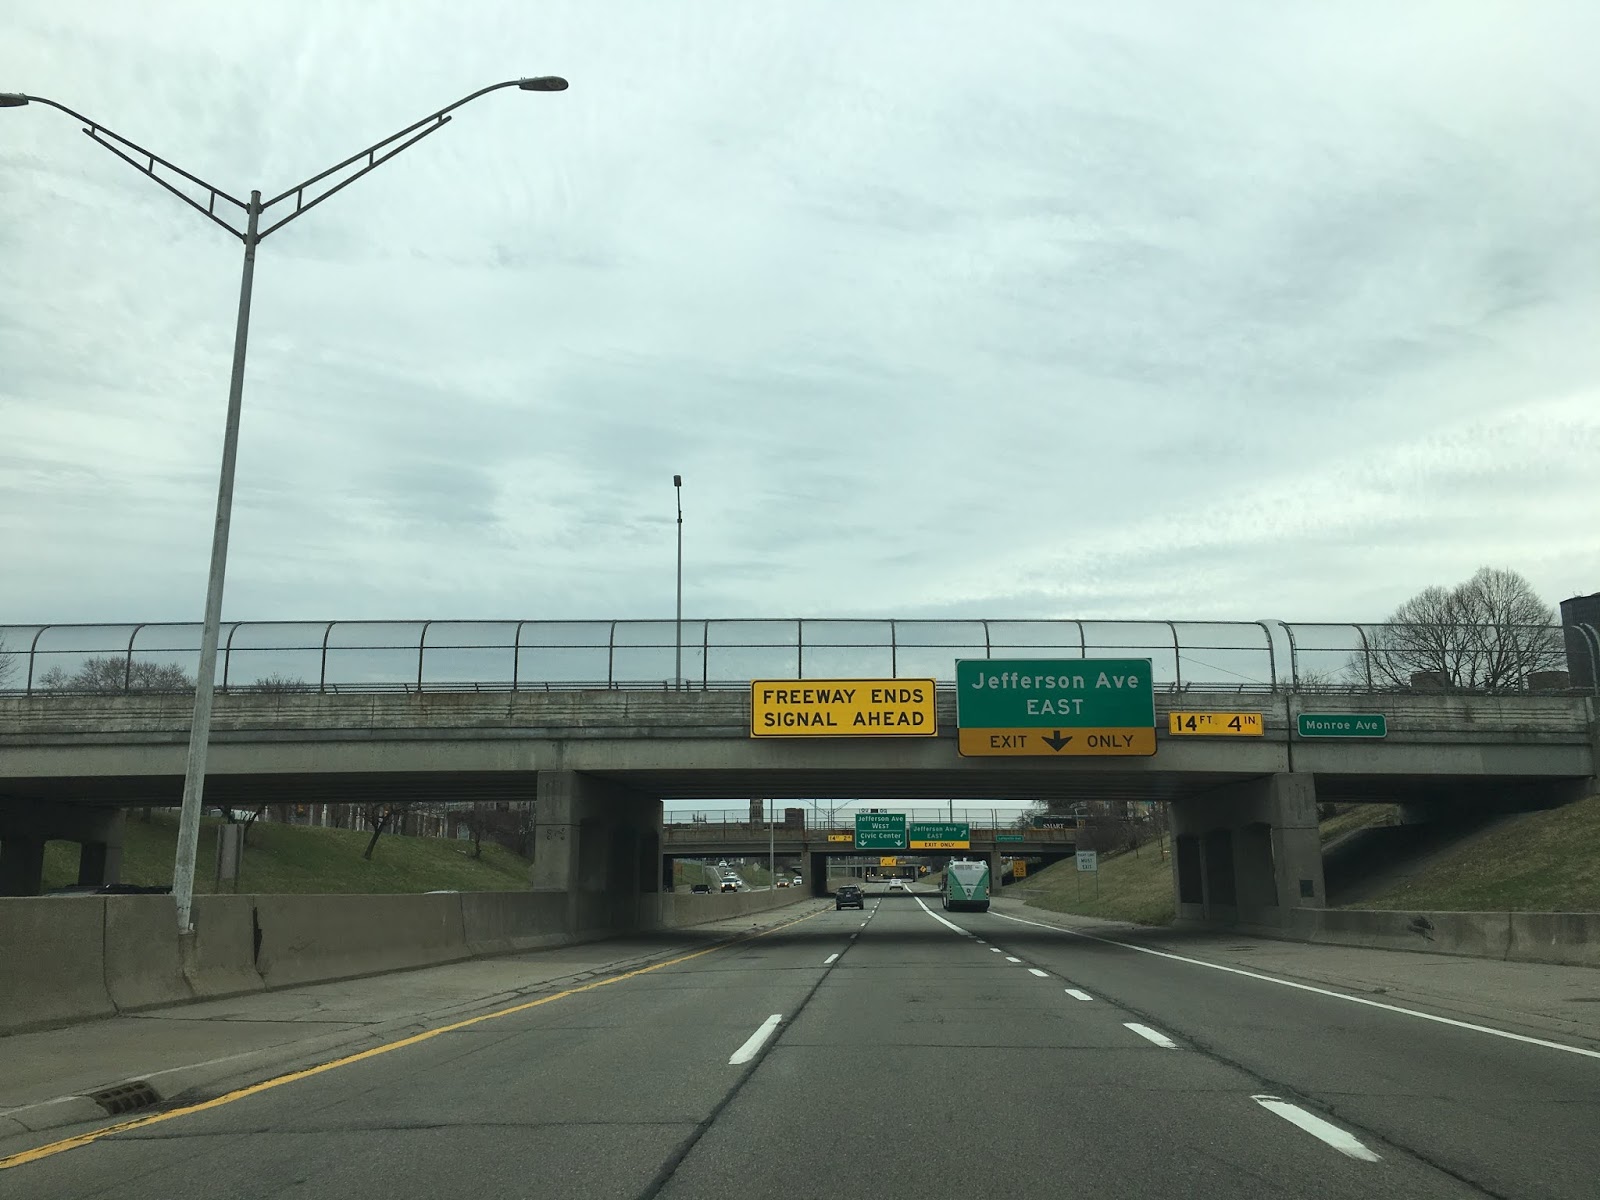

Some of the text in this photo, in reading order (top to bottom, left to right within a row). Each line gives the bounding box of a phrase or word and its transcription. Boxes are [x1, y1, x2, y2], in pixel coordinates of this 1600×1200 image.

[971, 671, 1139, 690] Jefferson Ave
[763, 688, 924, 705] FREEWAY ENDS
[1026, 699, 1084, 715] EAST
[764, 711, 924, 727] SIGNAL AHEAD
[1176, 715, 1197, 732] 14
[1227, 715, 1242, 731] 4
[1306, 719, 1378, 730] Monroe Ave
[990, 734, 1134, 748] EXIT ONLY
